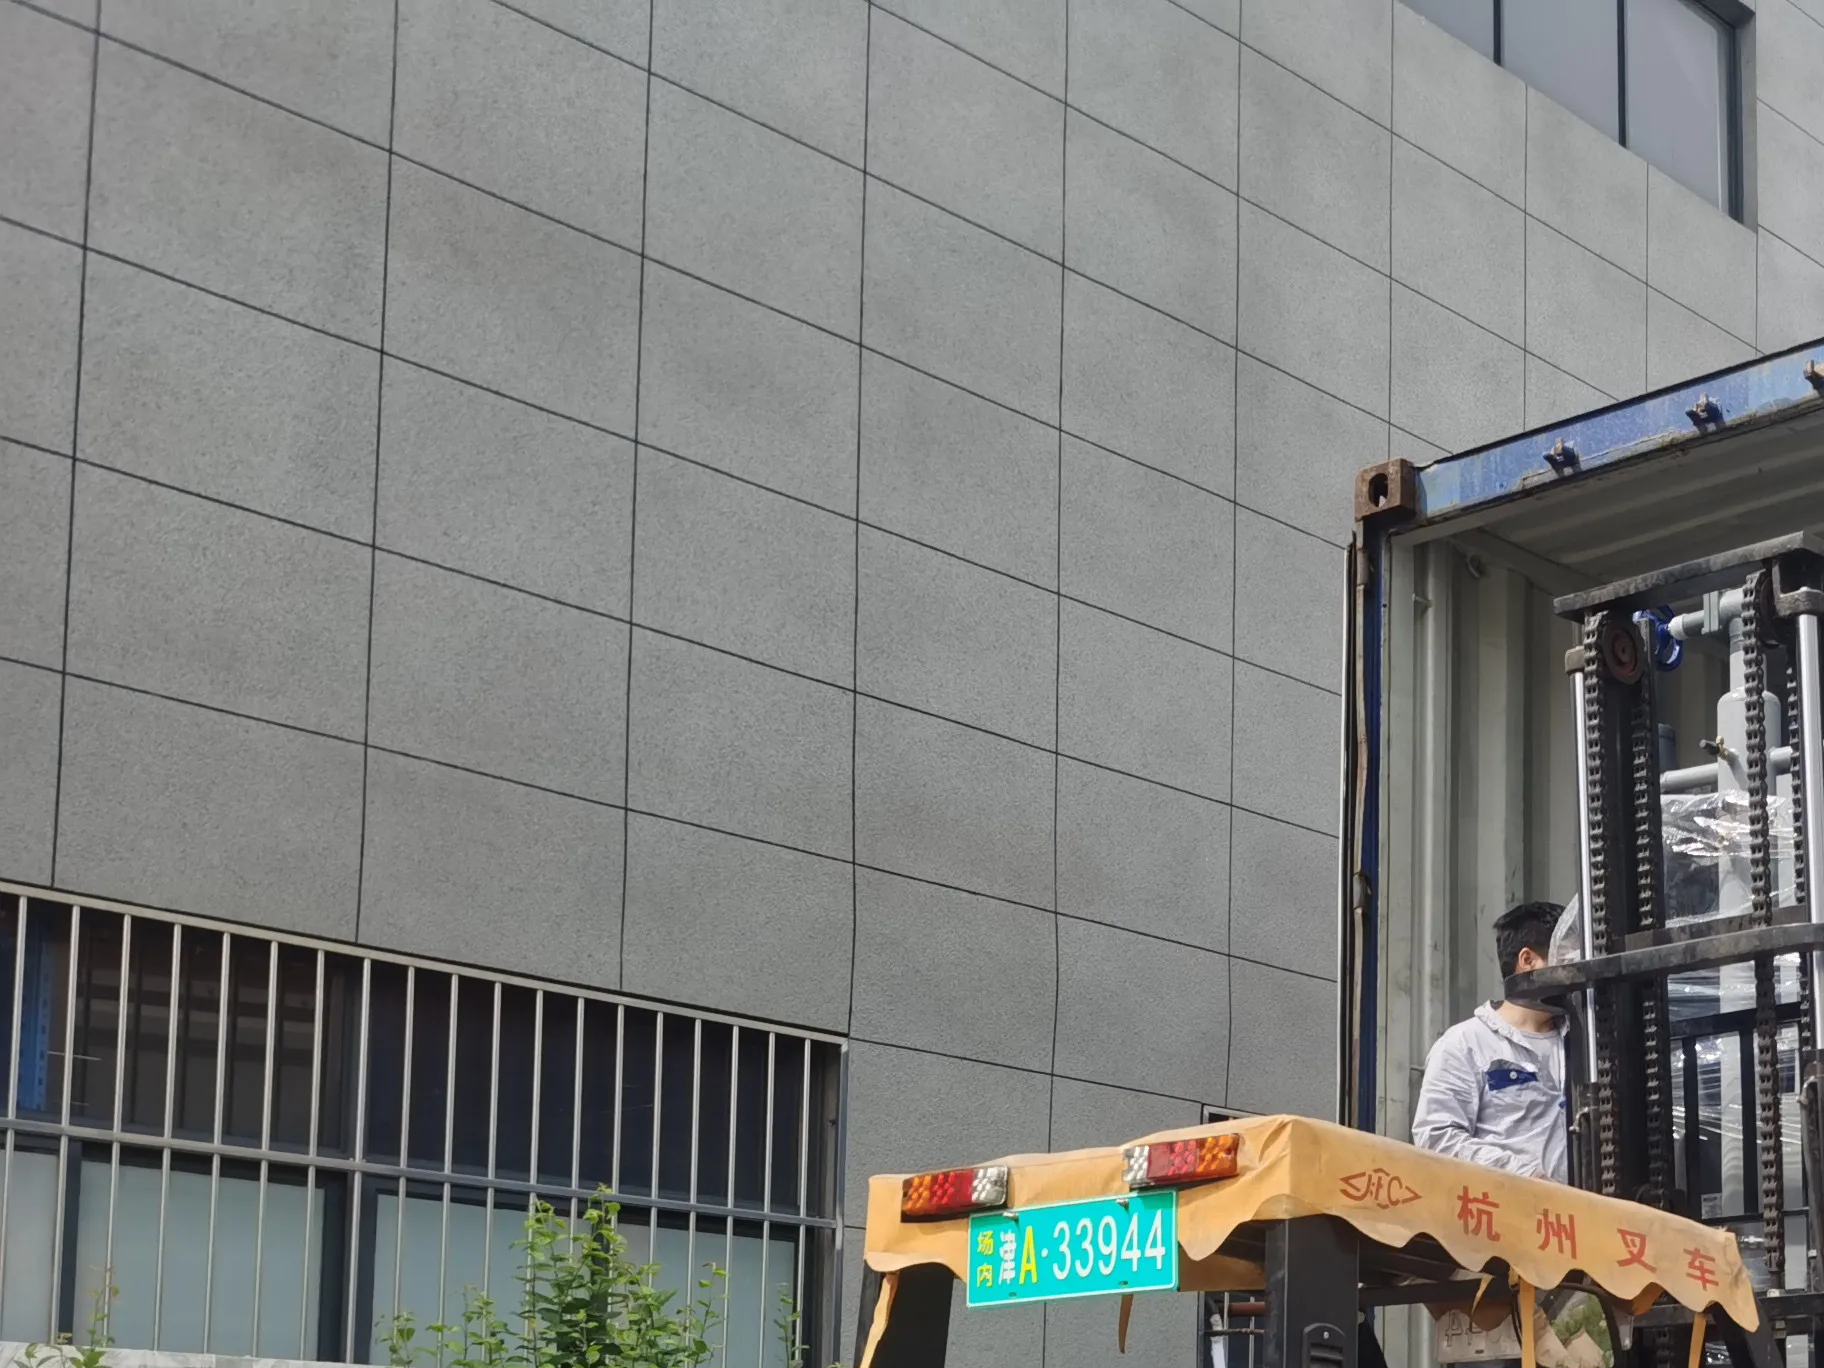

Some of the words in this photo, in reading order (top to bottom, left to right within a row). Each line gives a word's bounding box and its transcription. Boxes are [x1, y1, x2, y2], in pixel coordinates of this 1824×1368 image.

[976, 1229, 994, 1288] 场内
[1457, 1186, 1719, 1290] 杭州叉车
